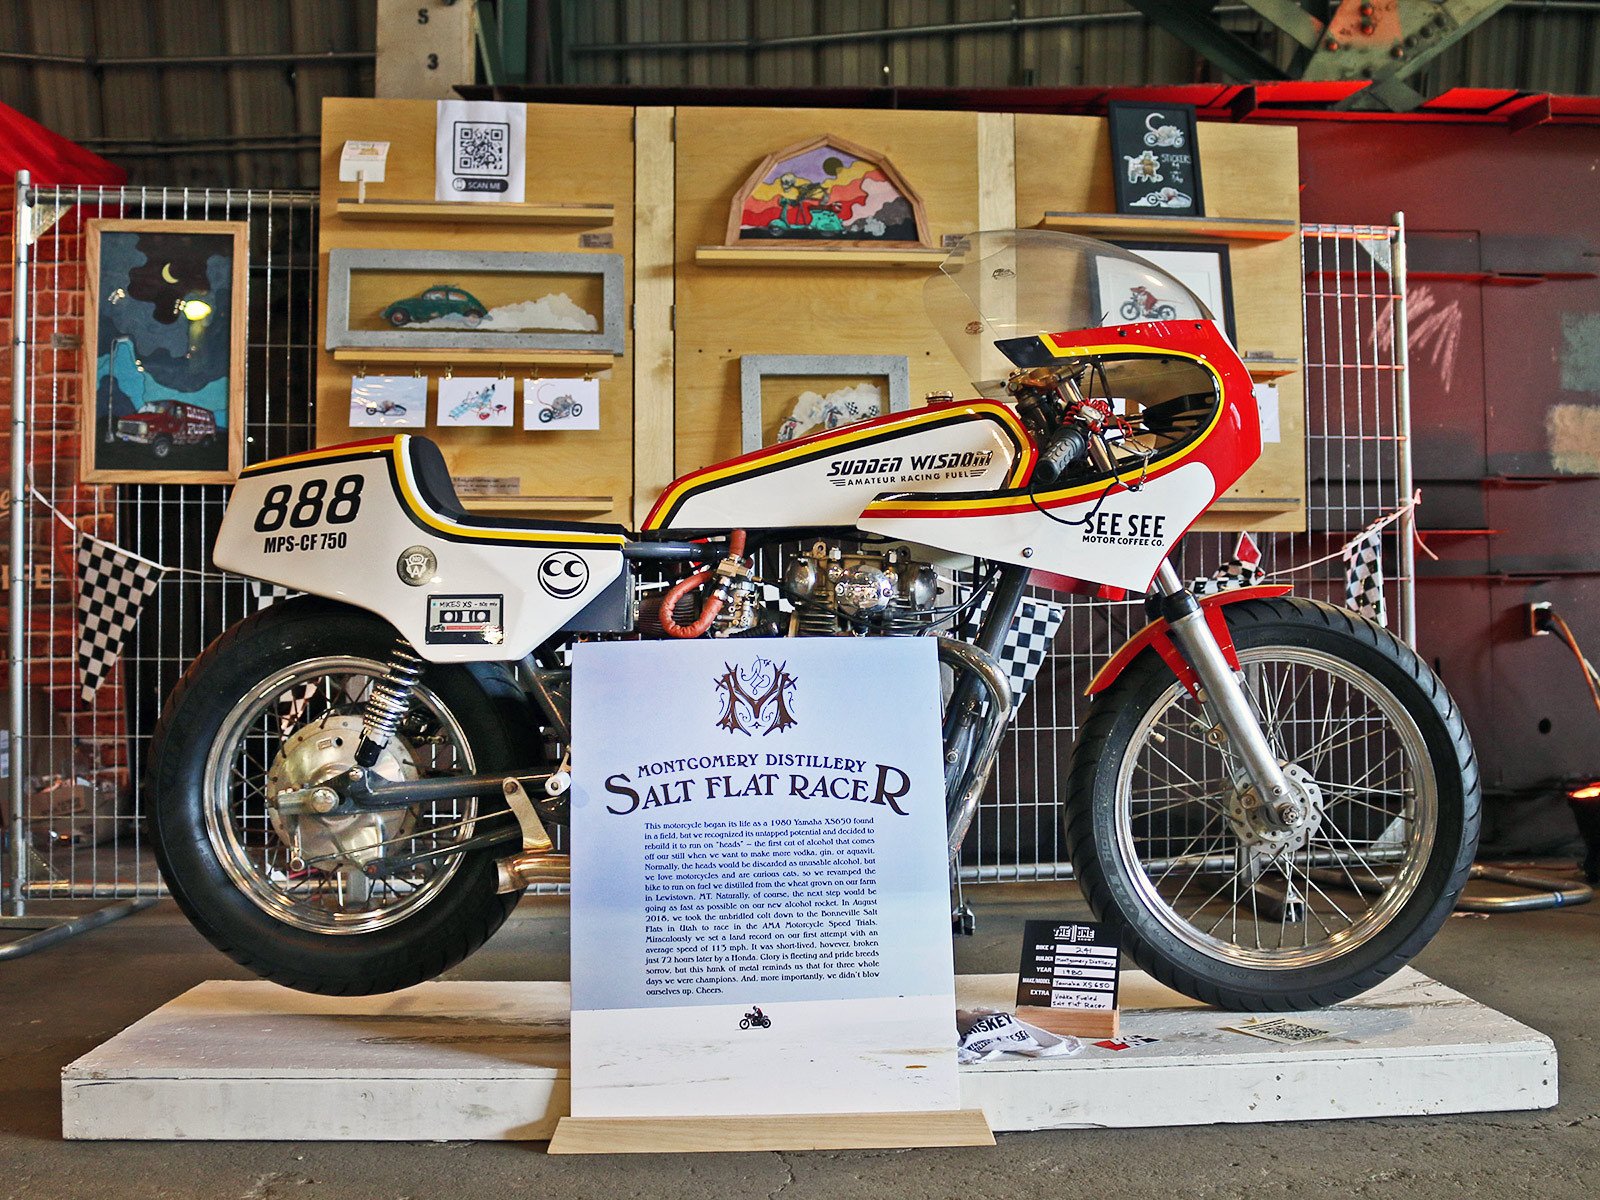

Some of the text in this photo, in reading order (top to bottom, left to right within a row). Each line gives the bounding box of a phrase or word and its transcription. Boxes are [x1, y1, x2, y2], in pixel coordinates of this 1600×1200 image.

[418, 8, 429, 24] S
[427, 54, 438, 70] 3
[468, 181, 501, 190] SCAN ME
[826, 450, 993, 476] SUDDEN WISDOM
[848, 470, 969, 486] AMATEUR RACING FUEL
[254, 474, 364, 532] 888
[1084, 512, 1166, 538] SEE SEE
[264, 532, 347, 554] MPS-CF 750
[1082, 536, 1116, 544] MOTOR
[1118, 538, 1149, 546] COFFEE
[638, 754, 866, 778] MONTGOMERY DISTILLERY
[604, 764, 911, 816] SALT FLAT RACER
[714, 954, 723, 963] by
